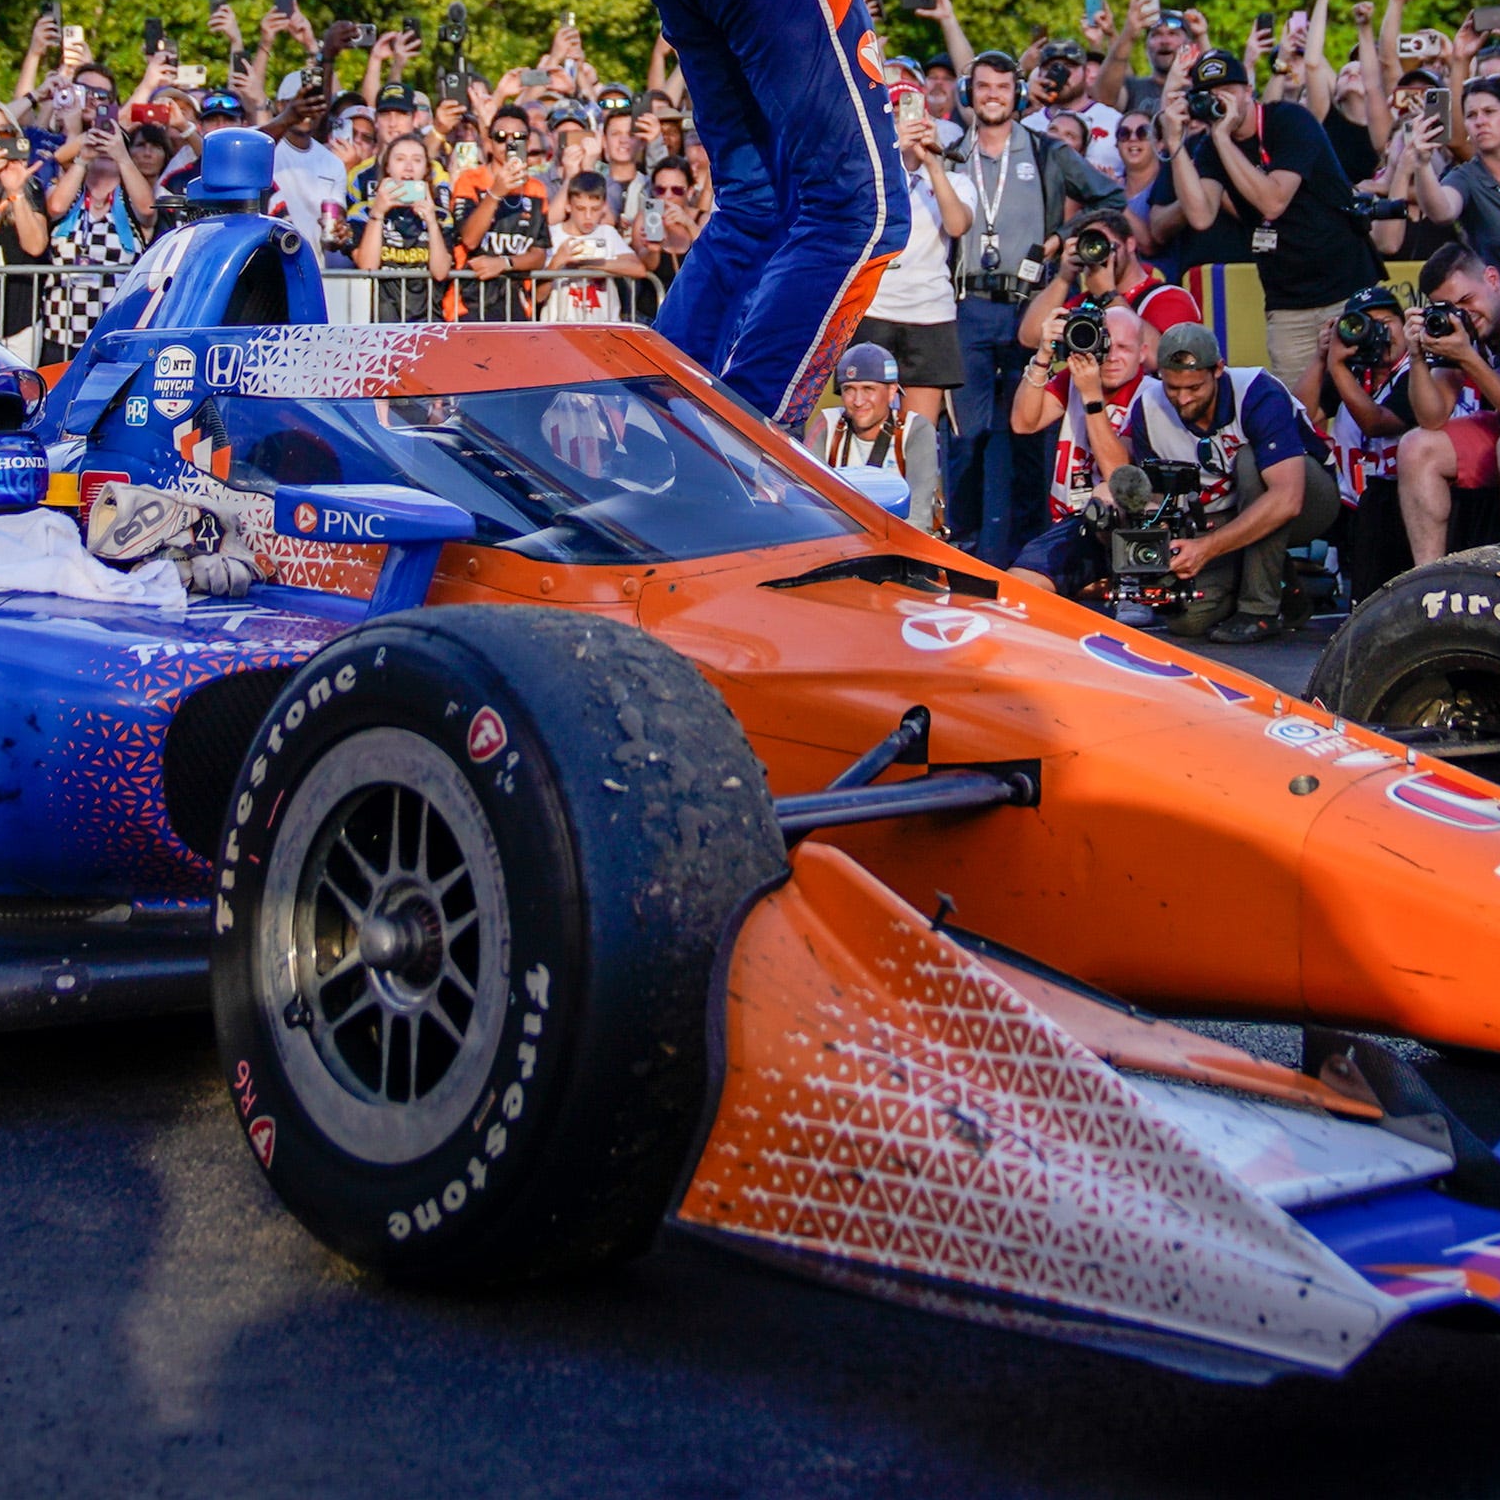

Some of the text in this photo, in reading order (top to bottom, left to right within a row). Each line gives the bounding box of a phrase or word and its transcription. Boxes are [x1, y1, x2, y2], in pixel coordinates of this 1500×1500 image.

[172, 359, 192, 371] NTT
[153, 378, 195, 392] INDYCAR
[126, 399, 148, 424] PPG
[322, 509, 386, 538] PNC
[215, 663, 357, 935] Firestone
[387, 962, 550, 1240] Firestone
